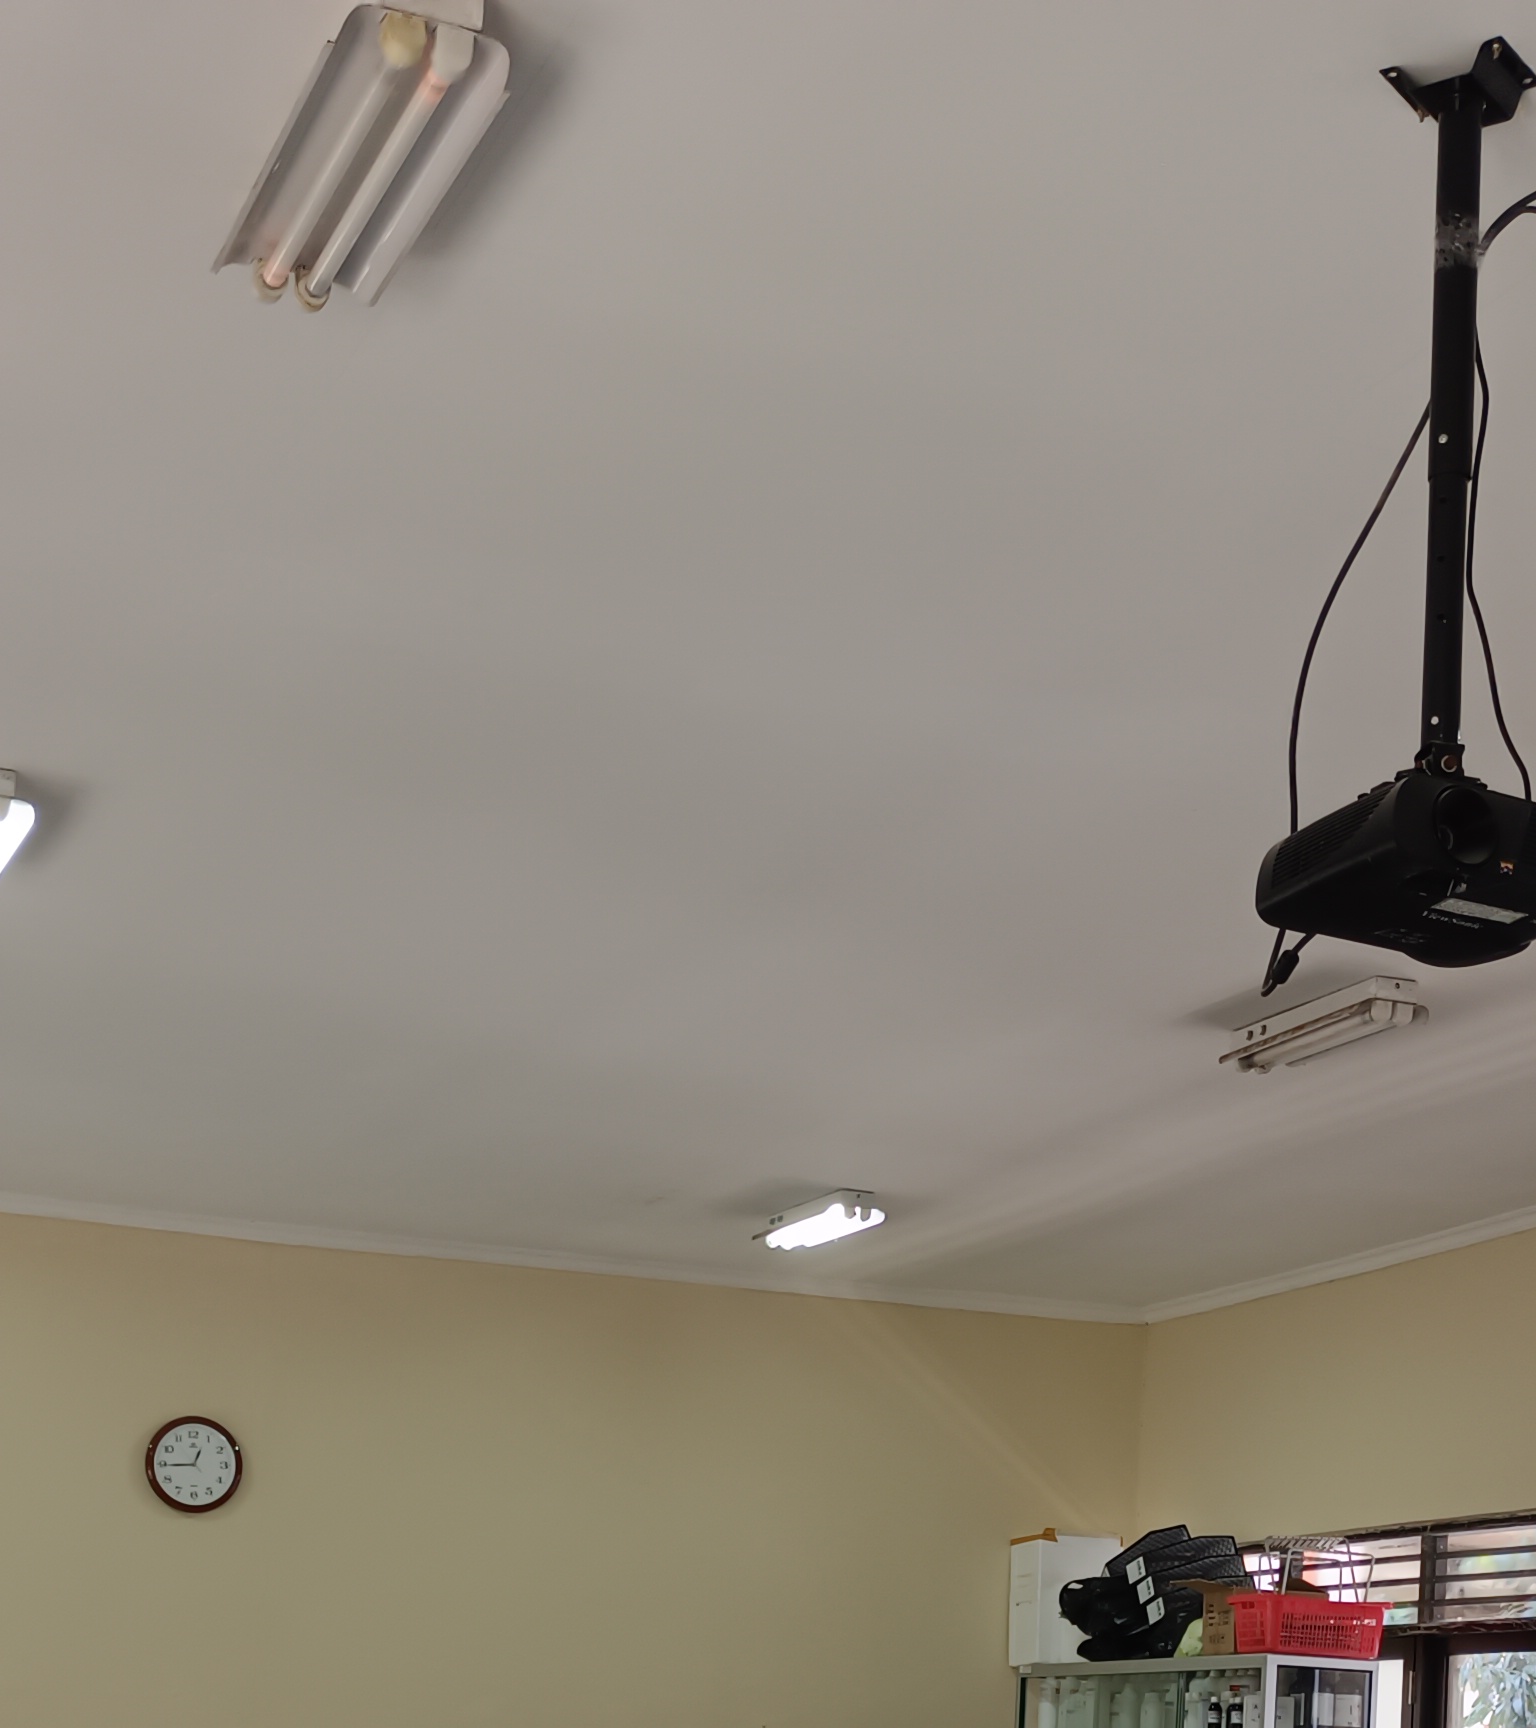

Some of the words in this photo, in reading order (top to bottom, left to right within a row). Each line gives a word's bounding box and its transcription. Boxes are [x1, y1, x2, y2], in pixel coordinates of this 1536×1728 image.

[188, 1430, 199, 1439] 12
[207, 1435, 210, 1443] 1
[164, 1444, 174, 1454] 10
[216, 1446, 224, 1454] 2
[220, 1461, 228, 1469] 3
[163, 1475, 173, 1484] 8
[216, 1476, 222, 1484] 4
[175, 1485, 182, 1495] 7
[205, 1487, 213, 1496] 5
[190, 1491, 198, 1499] 6
